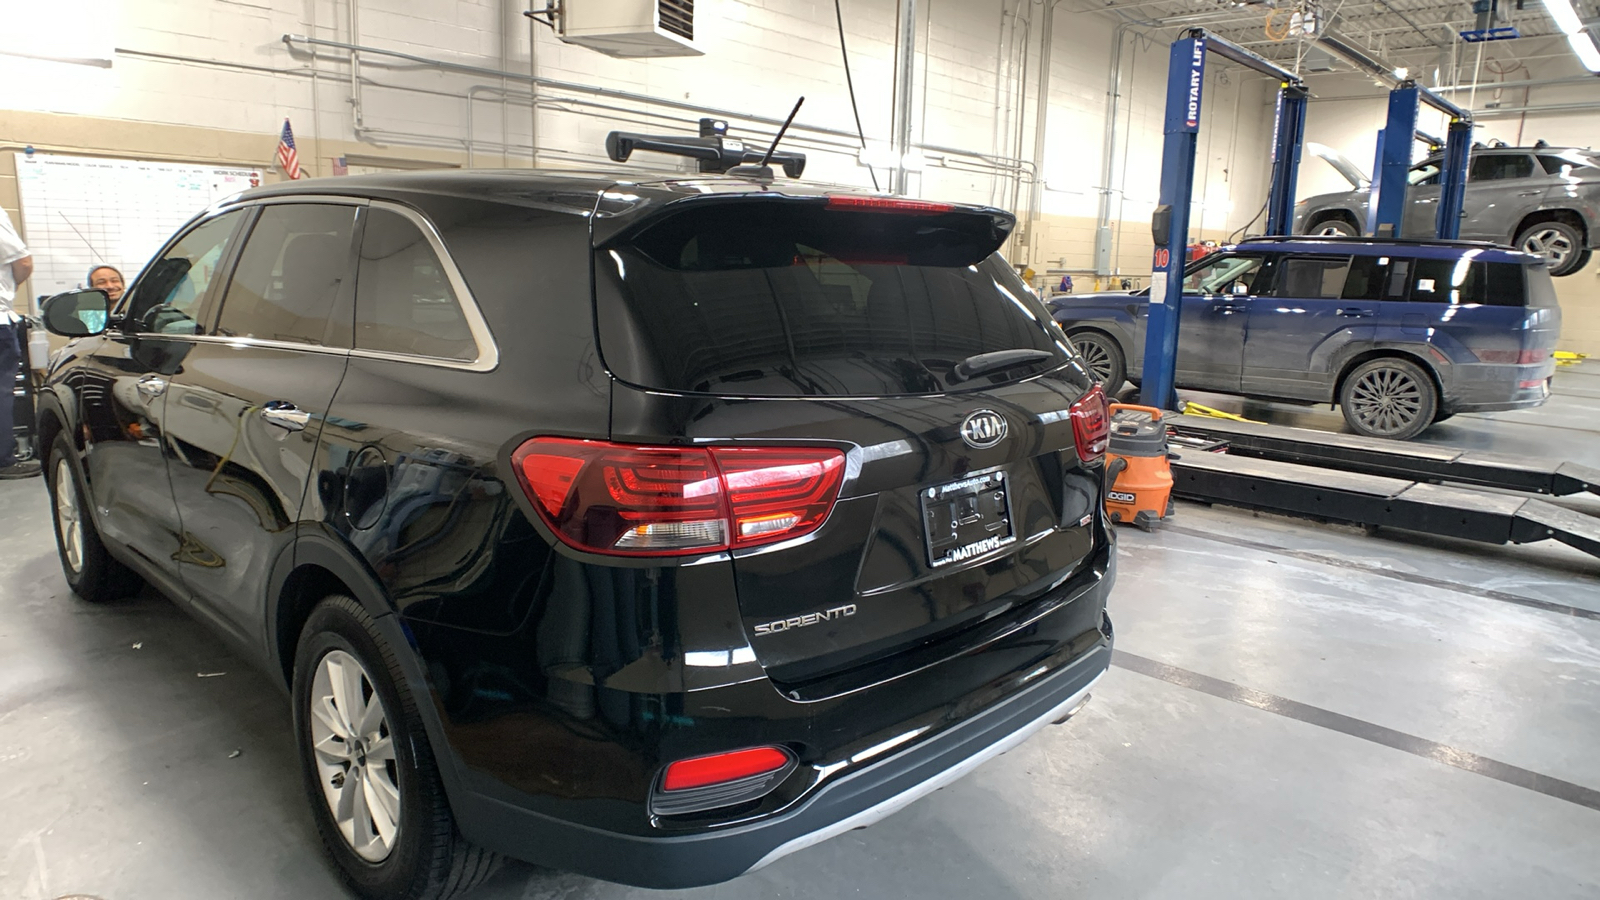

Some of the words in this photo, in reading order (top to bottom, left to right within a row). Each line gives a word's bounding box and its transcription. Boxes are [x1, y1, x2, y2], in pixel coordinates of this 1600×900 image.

[1192, 39, 1203, 67] LIFT
[1188, 69, 1200, 120] ROTARY
[1155, 248, 1170, 268] 10
[969, 416, 1001, 440] KIA
[1107, 491, 1135, 501] IDGID
[952, 535, 1000, 562] MATTHEWS
[754, 603, 857, 637] SORENTO
